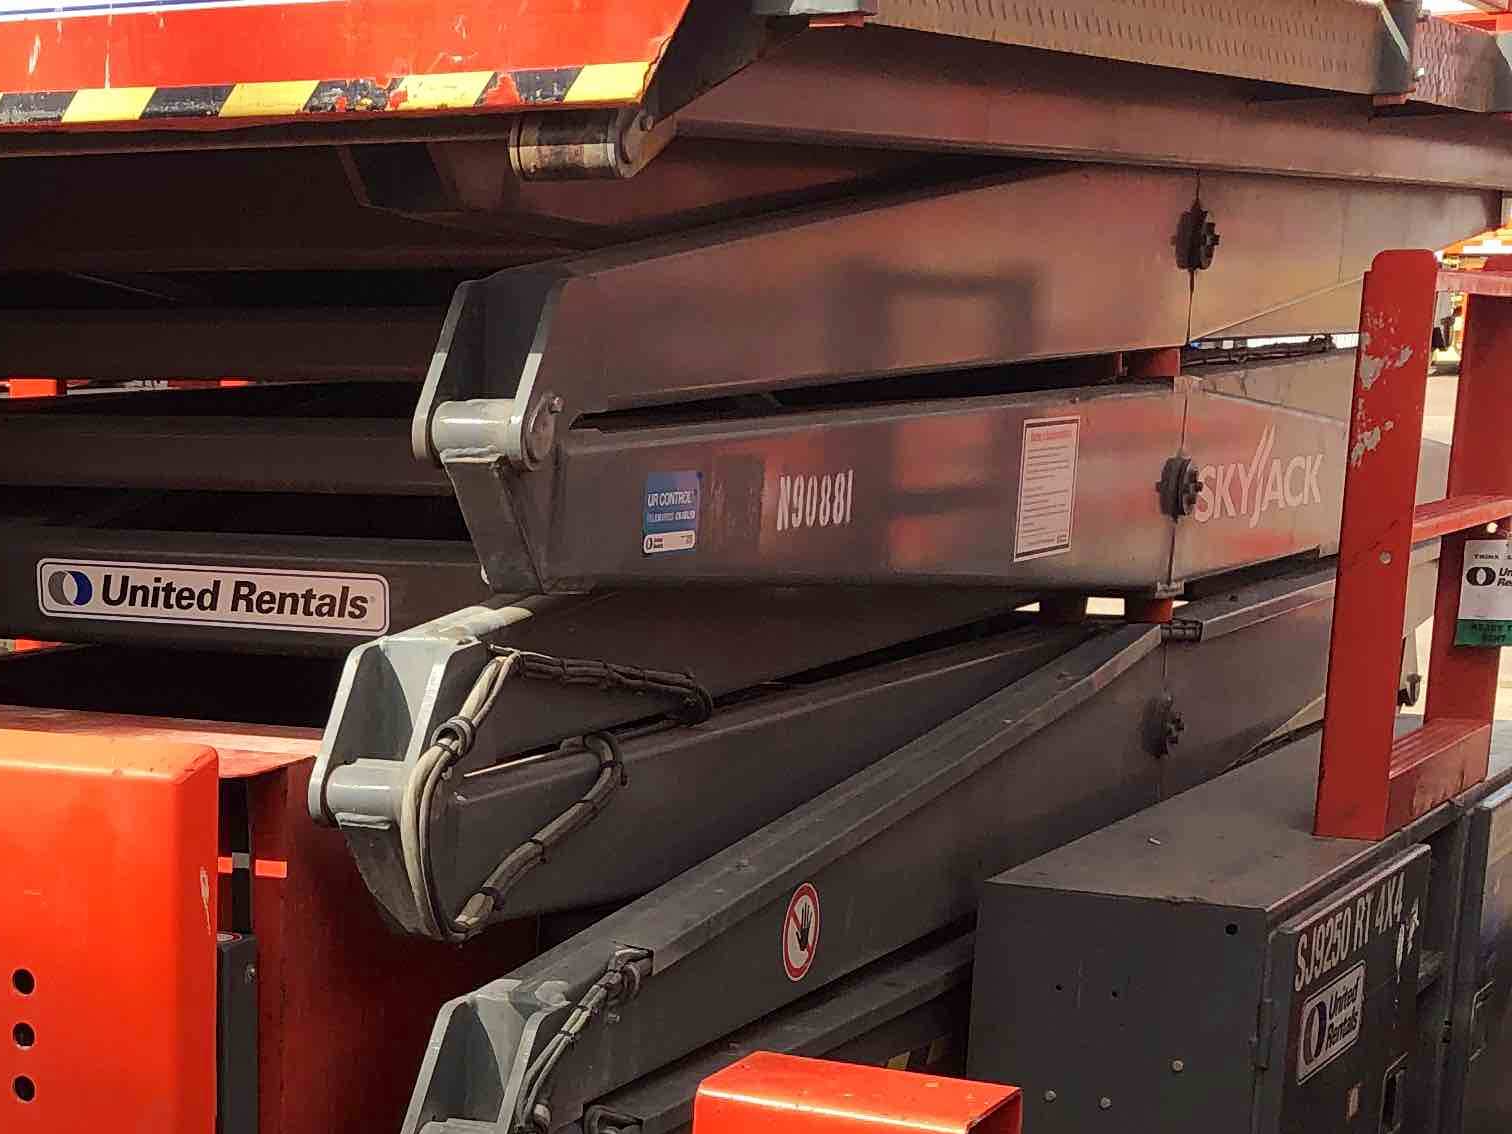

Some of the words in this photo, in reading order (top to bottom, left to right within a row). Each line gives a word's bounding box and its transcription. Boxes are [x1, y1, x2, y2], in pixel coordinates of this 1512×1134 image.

[777, 469, 853, 531] N90881
[1194, 423, 1324, 528] SKYJACK
[102, 574, 221, 611] United
[230, 580, 368, 619] Rentals
[1295, 906, 1352, 992] SJ9250
[1353, 893, 1373, 951] RT
[1329, 976, 1358, 1020] United
[1326, 1012, 1358, 1050] Rentals
